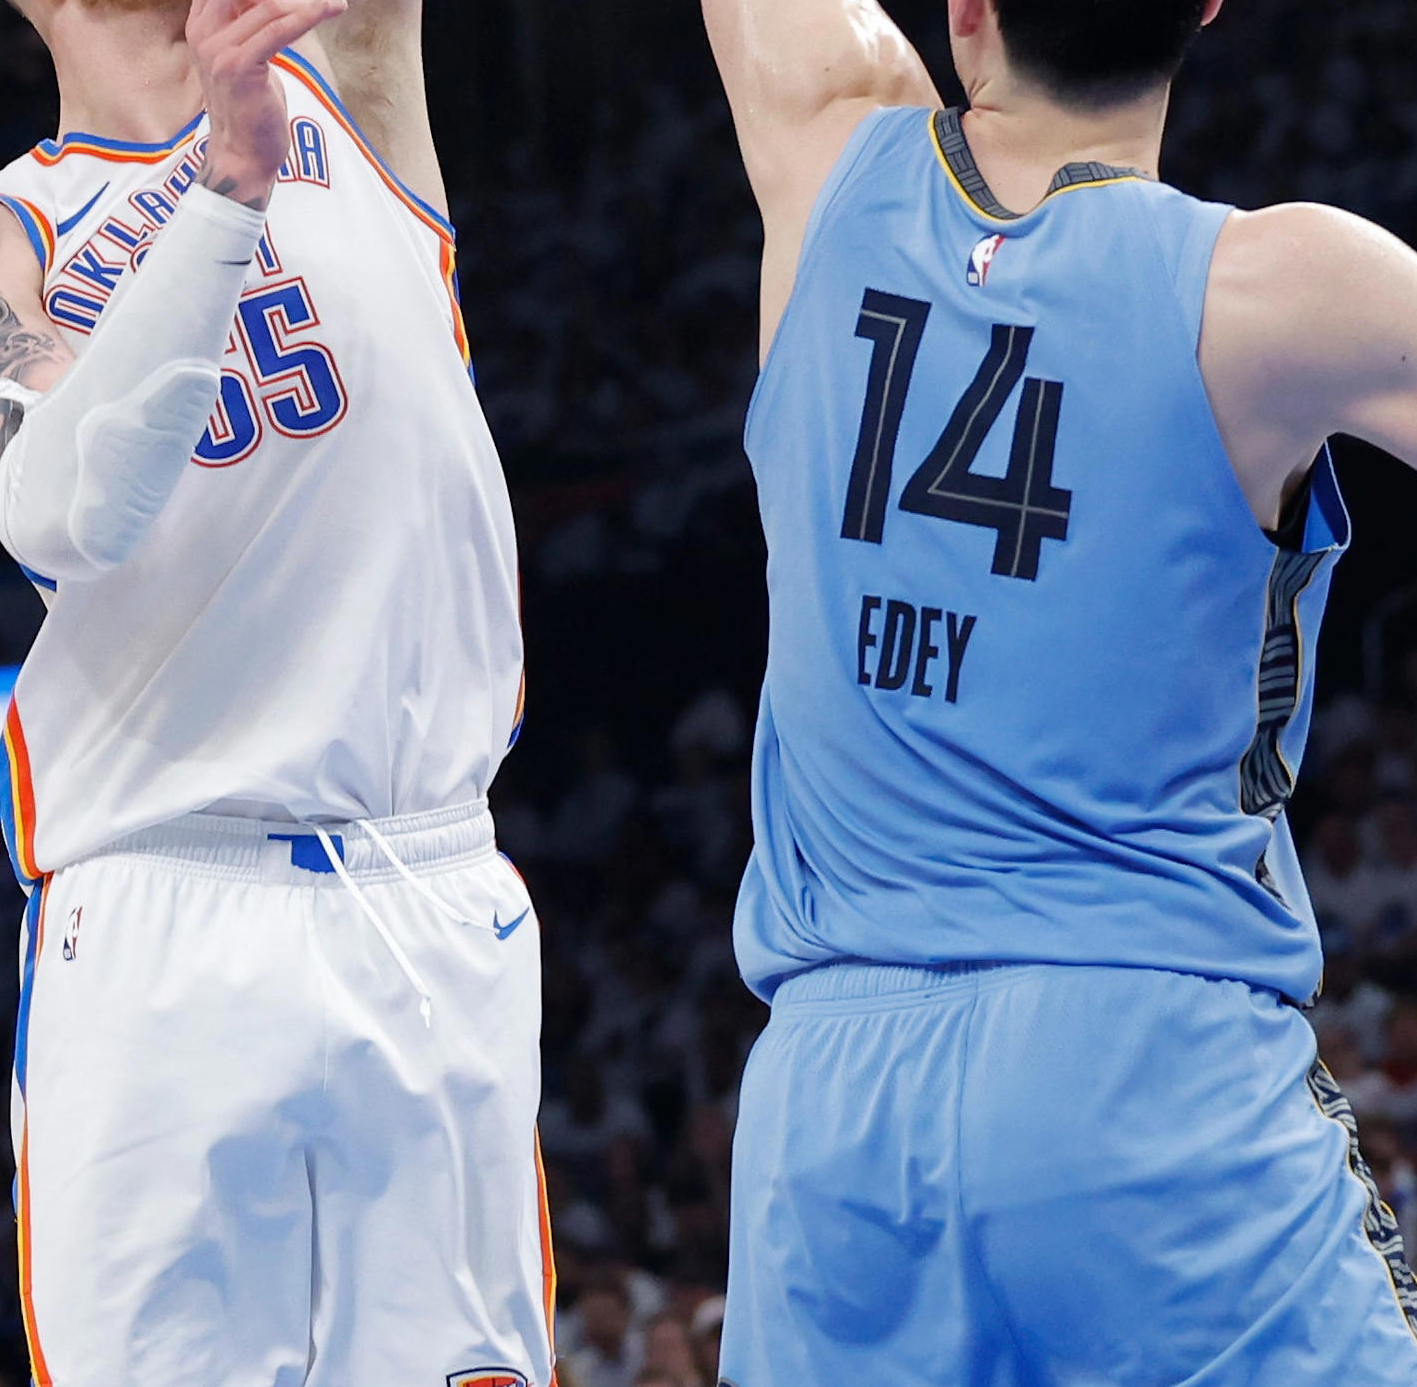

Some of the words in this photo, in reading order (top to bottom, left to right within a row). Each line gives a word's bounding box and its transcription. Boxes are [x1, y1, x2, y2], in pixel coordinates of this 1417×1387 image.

[44, 116, 330, 336] OKLAHA
[840, 286, 1073, 583] 14
[857, 595, 978, 704] EDEY
